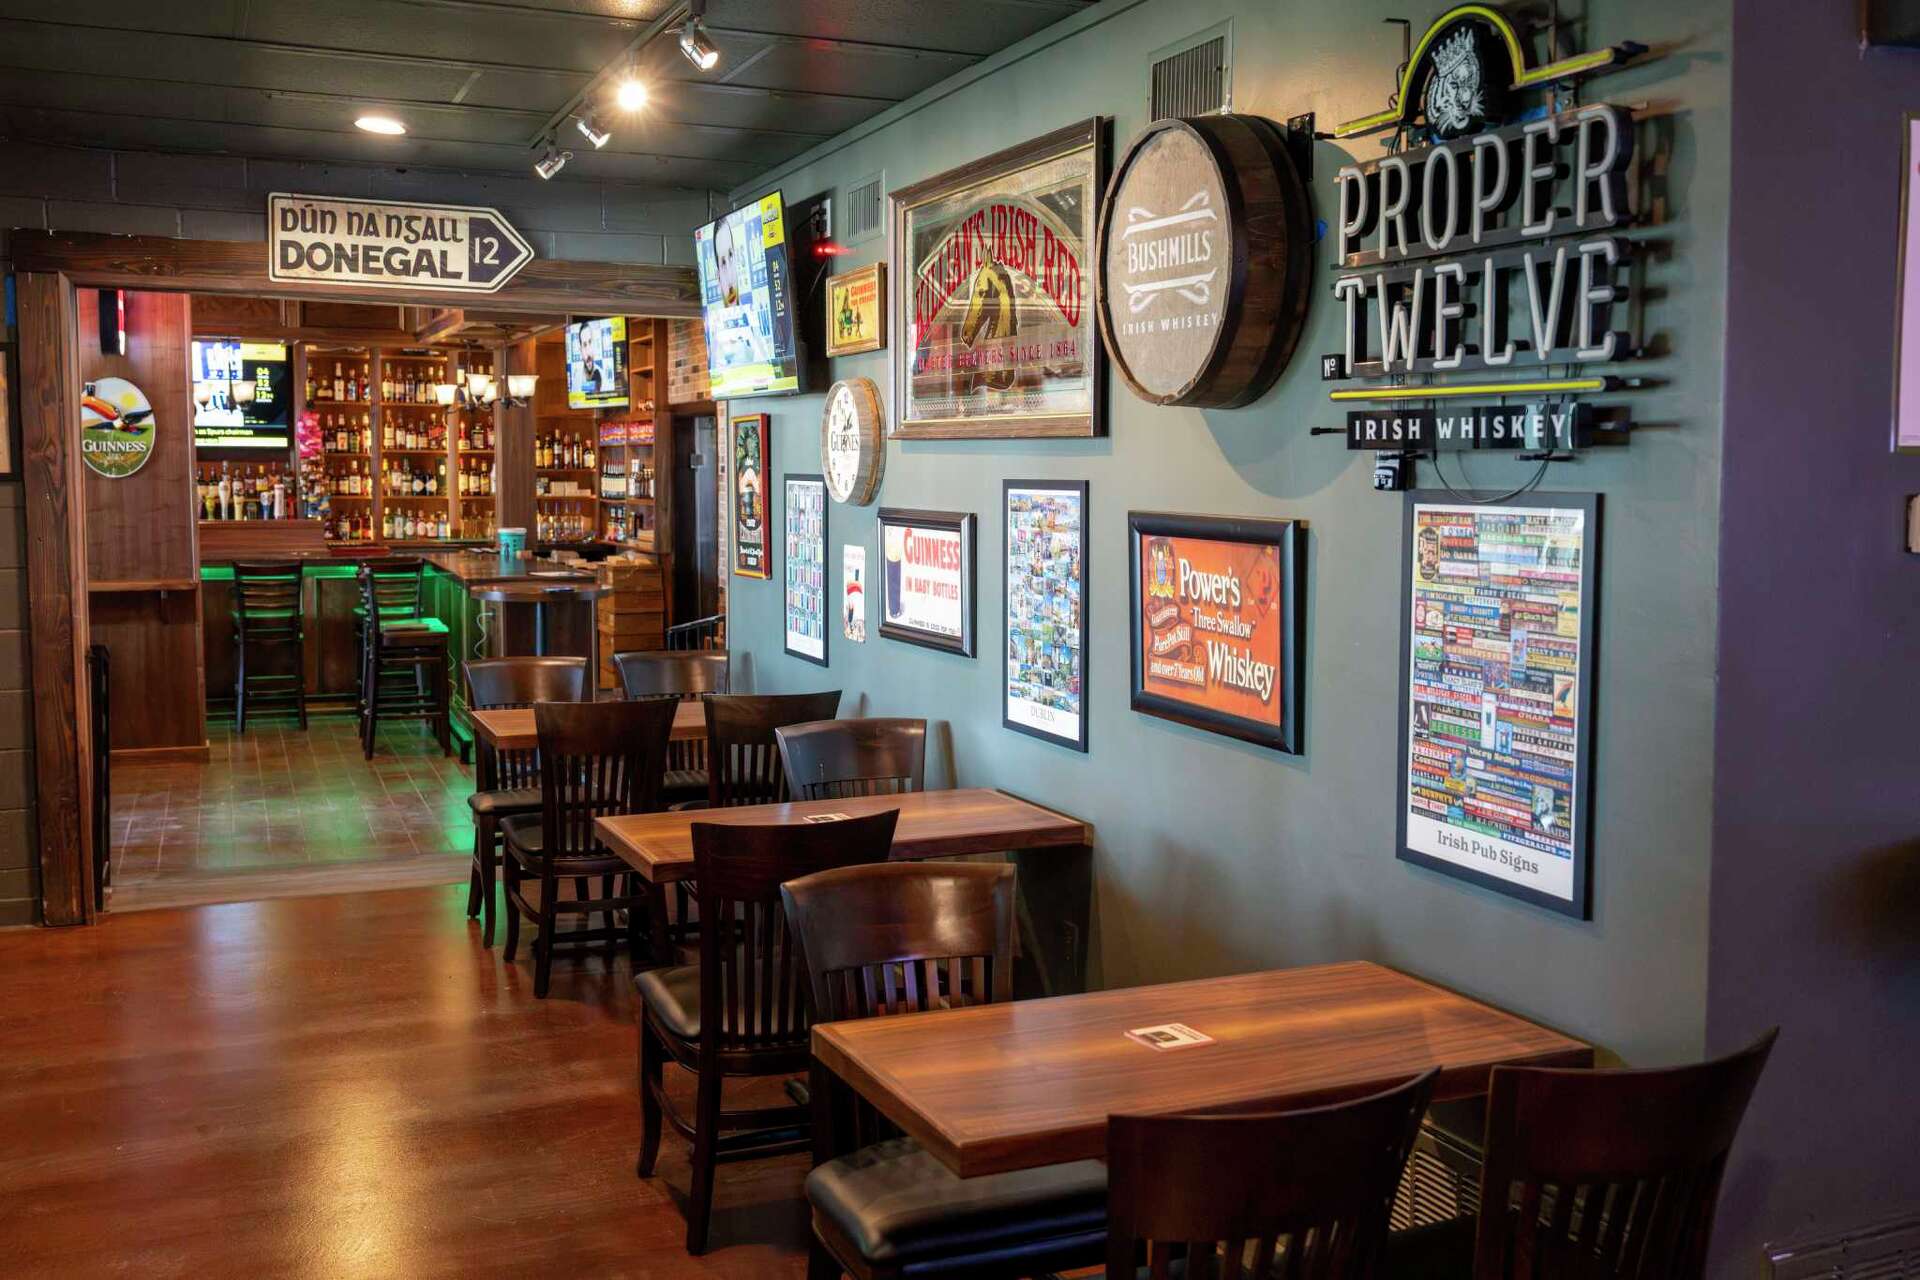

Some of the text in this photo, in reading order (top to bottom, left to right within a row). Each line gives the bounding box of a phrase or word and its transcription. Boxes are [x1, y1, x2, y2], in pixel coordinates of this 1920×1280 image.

[1338, 104, 1619, 267] PROPER
[279, 239, 463, 281] DONEGAL
[473, 237, 500, 266] 12
[1127, 231, 1212, 274] BUSHMILLS
[915, 204, 1082, 351] KILLIAN'S IRISH RED
[1122, 312, 1219, 336] IRISH WHISKEY
[1335, 239, 1618, 376] TWELVE
[1009, 343, 1042, 362] SINCE
[1049, 339, 1077, 358] 1864
[82, 440, 147, 452] GUINNESS
[1354, 413, 1566, 441] IRISH WHISKEY
[904, 526, 960, 571] GUINNESS
[905, 576, 913, 592] IN
[933, 580, 958, 601] BOTTLES
[1179, 558, 1241, 607] Power's
[1207, 640, 1275, 700] Whiskey
[1437, 830, 1539, 874] Irish Pub Signs
